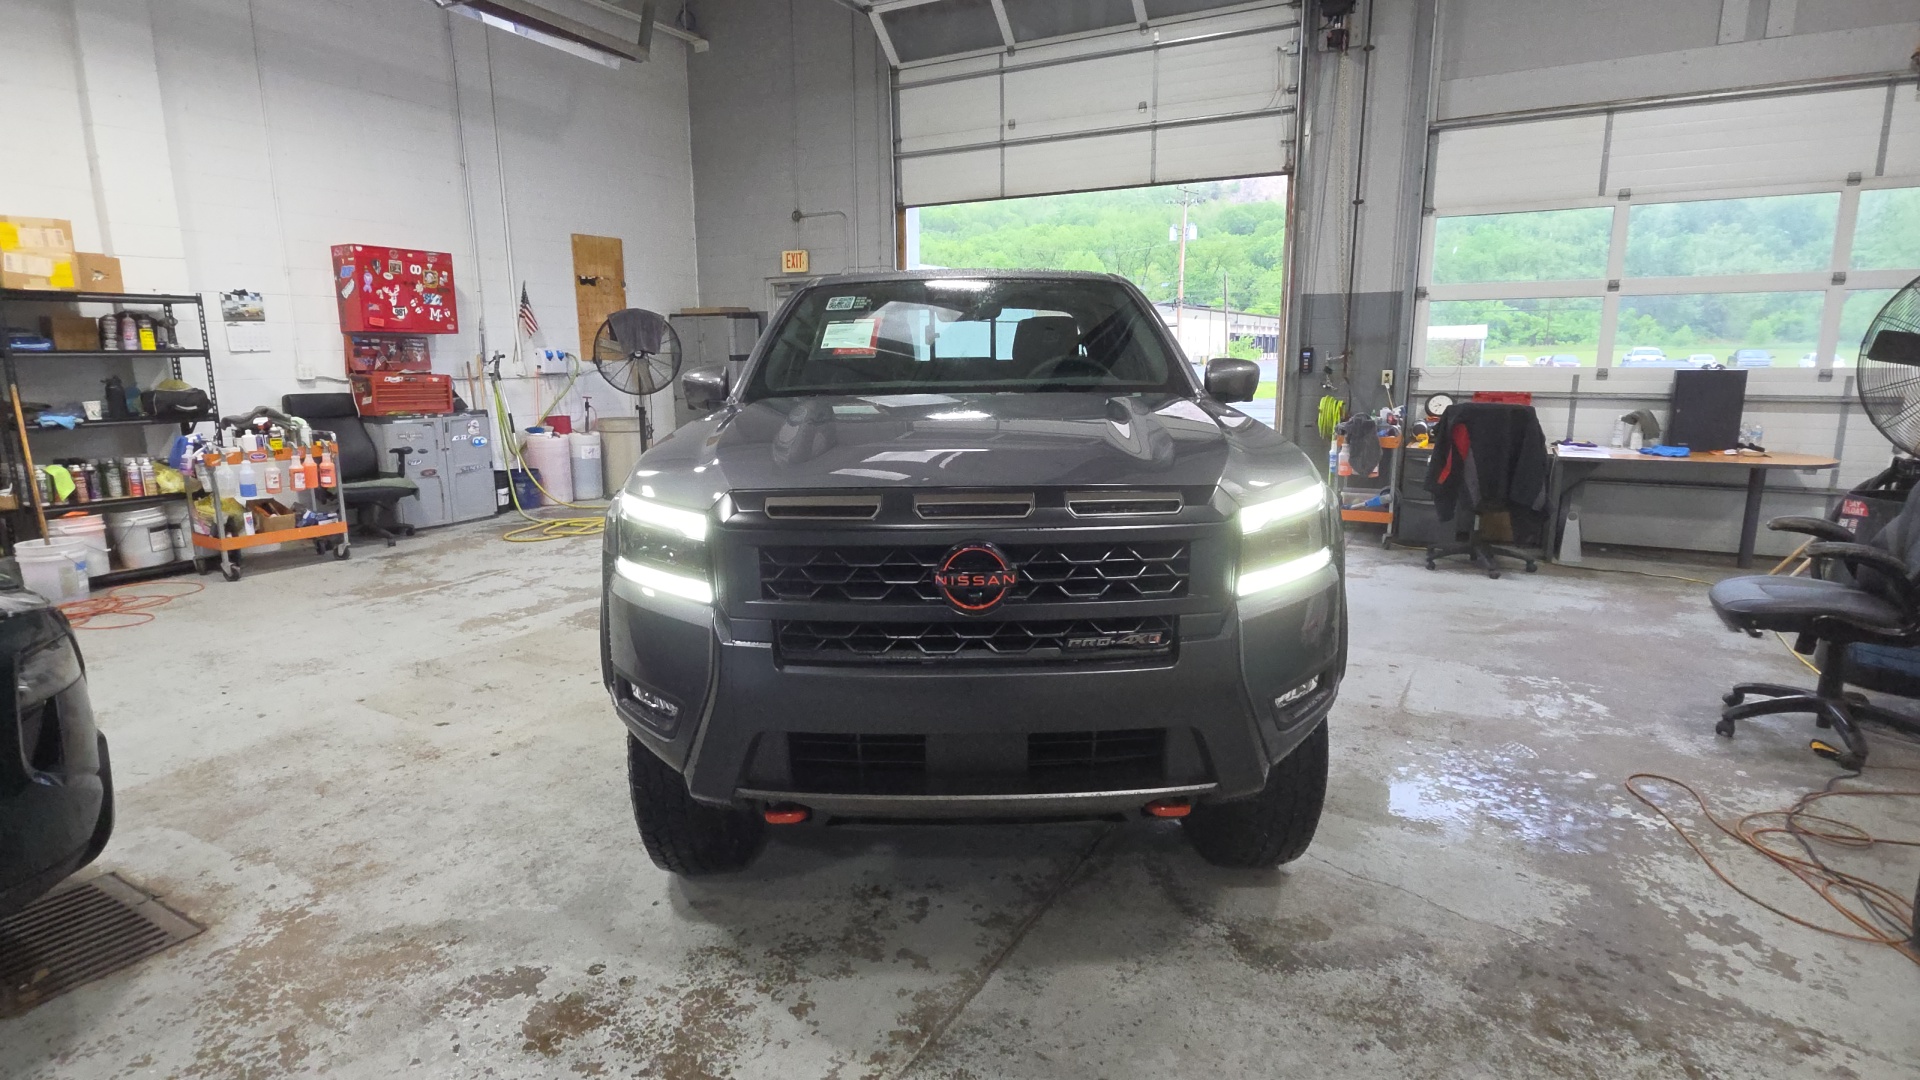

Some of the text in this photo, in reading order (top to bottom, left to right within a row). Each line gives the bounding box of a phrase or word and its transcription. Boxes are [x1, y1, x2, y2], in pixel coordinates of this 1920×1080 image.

[786, 252, 803, 269] EXIT
[935, 574, 1016, 587] NISSAN
[1067, 633, 1147, 648] PRO-4X
